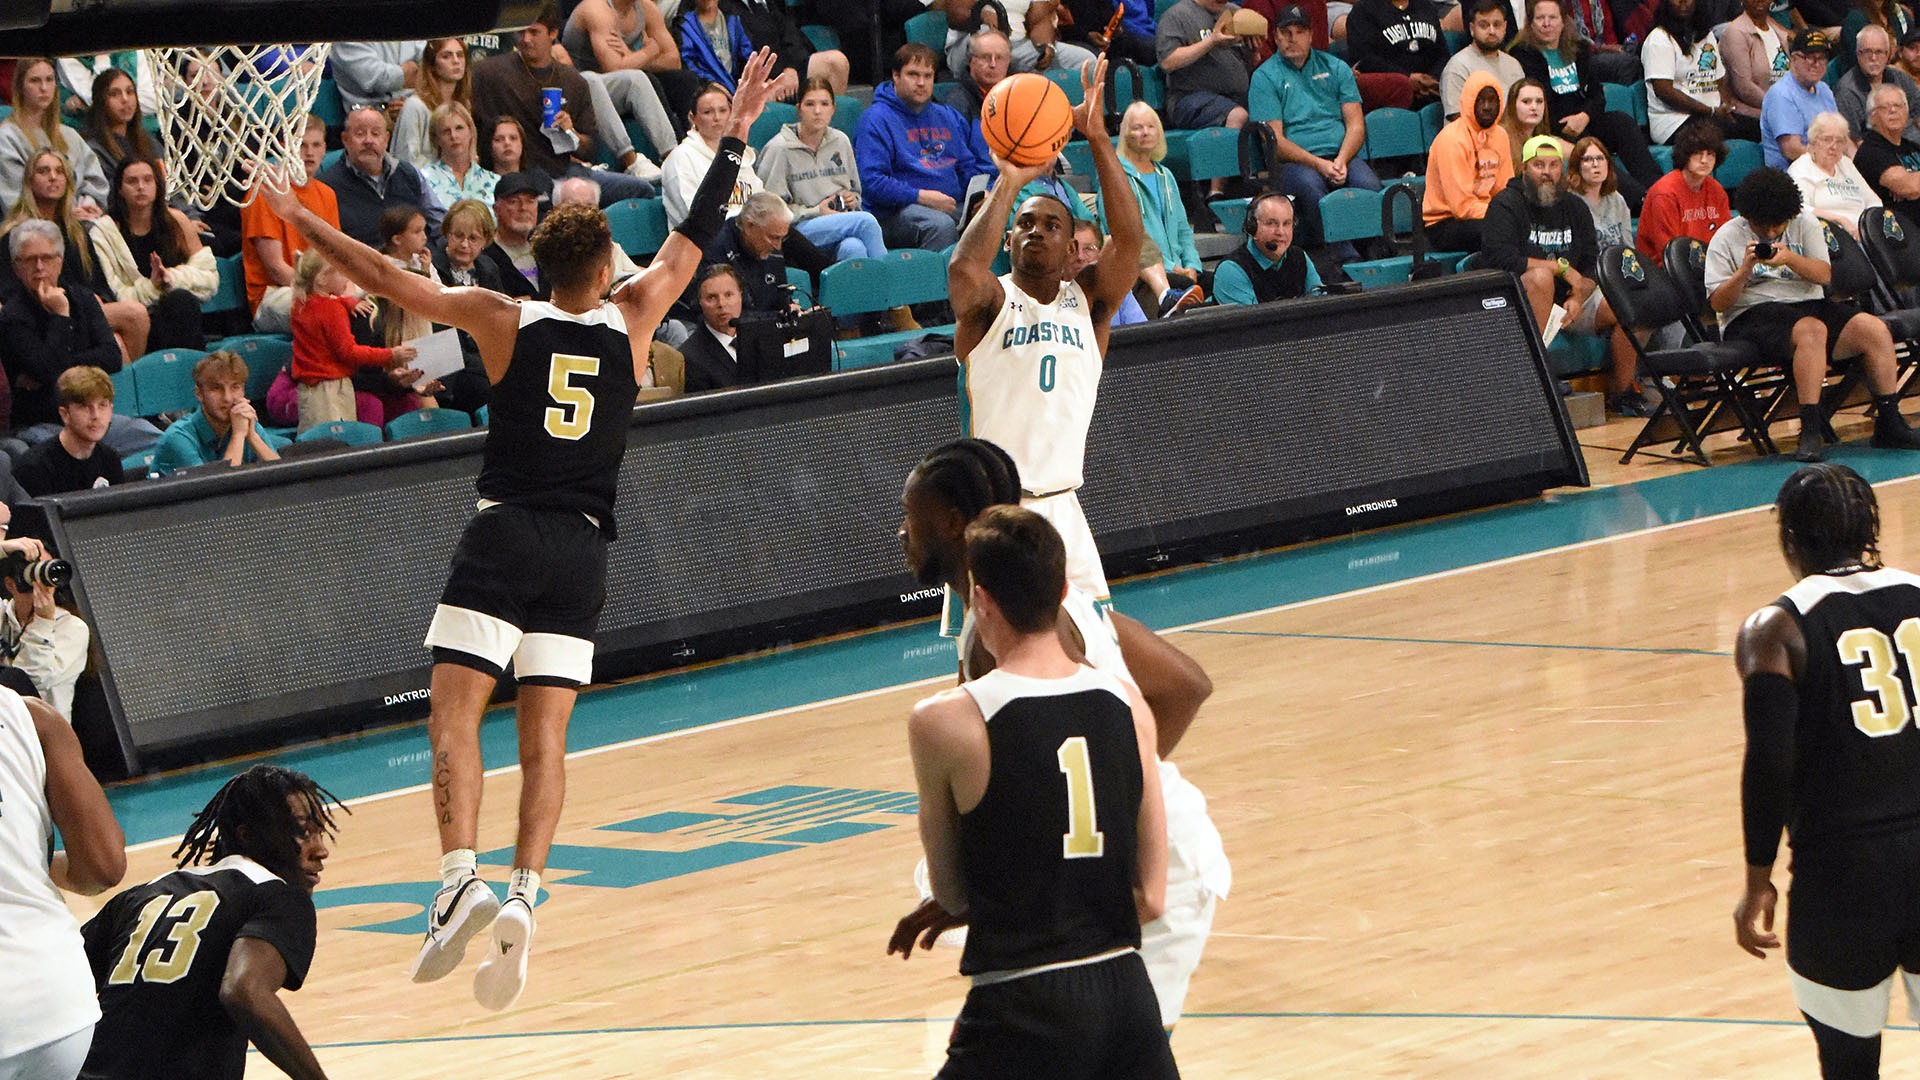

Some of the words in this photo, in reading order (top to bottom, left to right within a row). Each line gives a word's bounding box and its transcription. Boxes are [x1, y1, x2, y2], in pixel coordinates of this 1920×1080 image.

[1002, 321, 1084, 350] COASTAL
[1039, 354, 1057, 393] 0
[543, 352, 600, 441] 5
[1345, 498, 1399, 516] DAKTRONICS
[900, 585, 945, 603] DAKTRON
[1057, 736, 1104, 859] 1
[108, 890, 221, 985] 13
